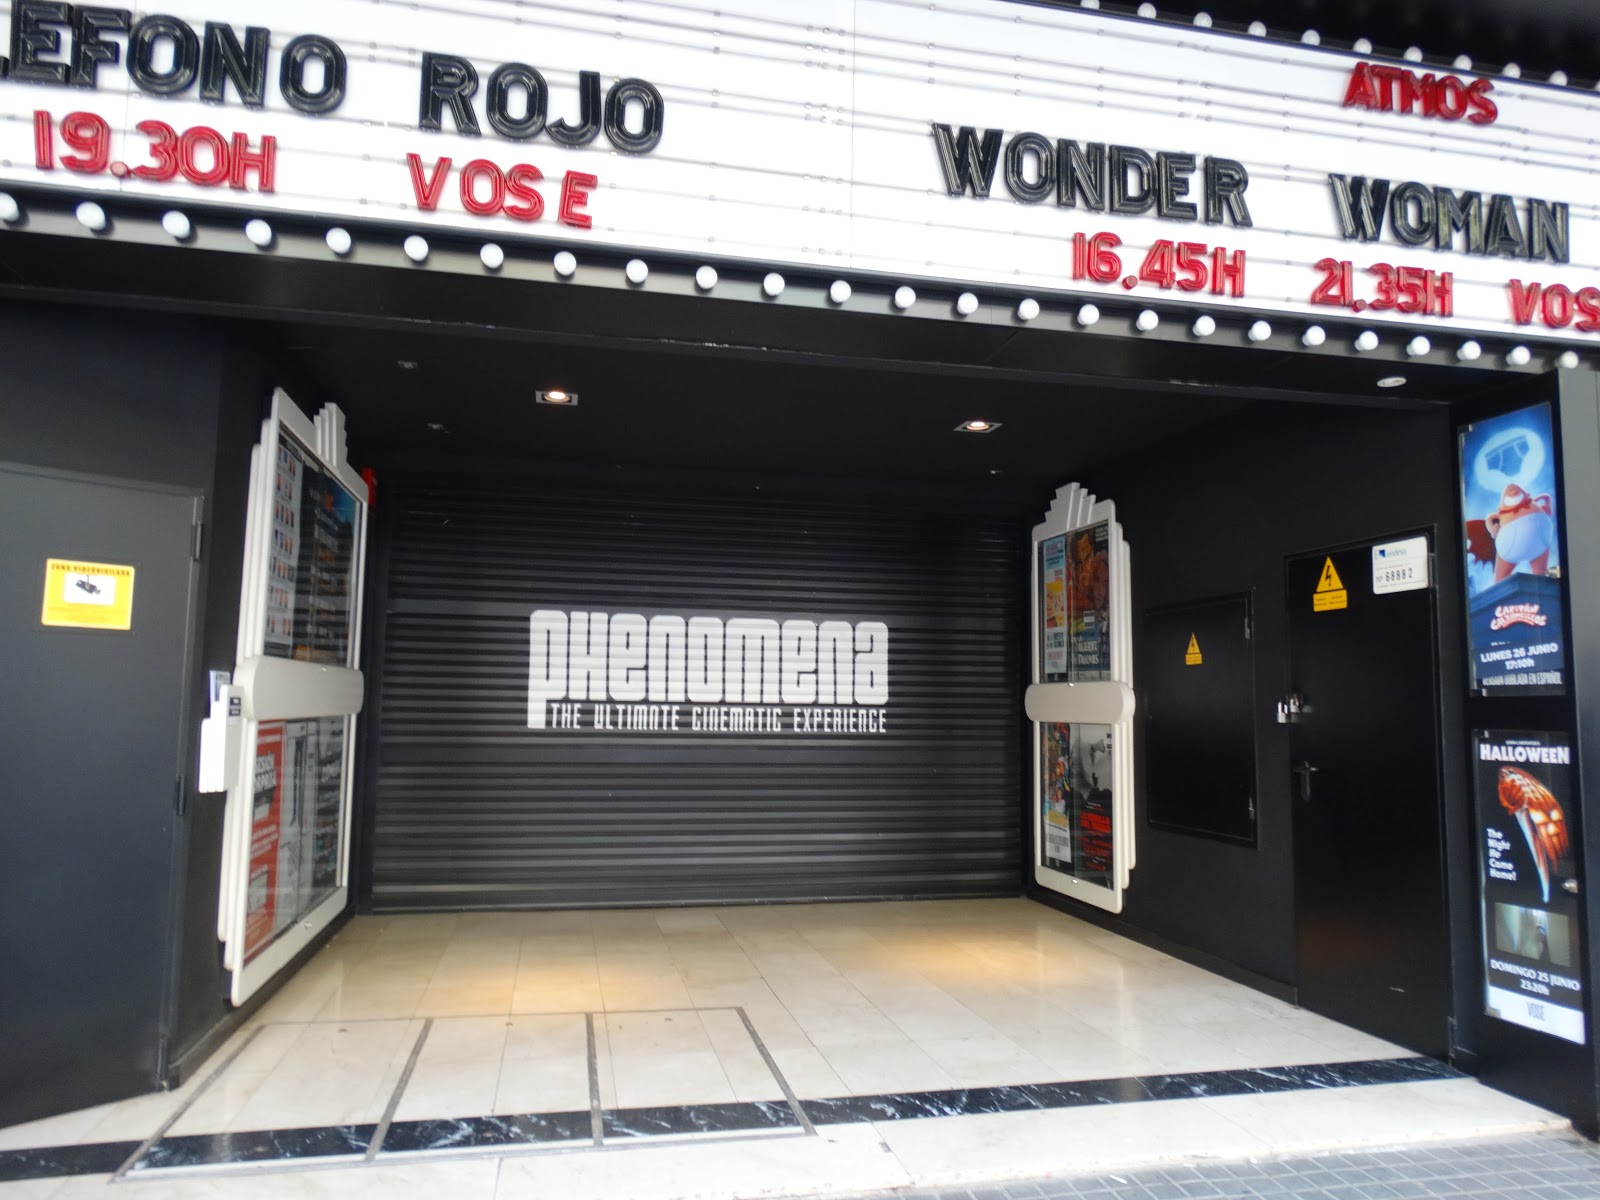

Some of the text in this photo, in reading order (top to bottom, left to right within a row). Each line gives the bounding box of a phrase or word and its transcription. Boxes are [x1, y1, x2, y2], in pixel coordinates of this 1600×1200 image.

[0, 0, 665, 154] EFONO ROJO
[1342, 61, 1499, 126] ATMOS
[32, 109, 598, 229] 19.30H VOSE
[931, 122, 1570, 263] WONDER WOMAN
[1072, 231, 1600, 333] 16.45H 21.35H VOS
[1480, 650, 1512, 662] LUNES
[1527, 642, 1558, 656] JUNIO
[551, 703, 888, 734] THE ULTIMATE CINEMATIC EXPERIENCE
[1480, 743, 1570, 764] HALLOWEEN
[1486, 828, 1503, 840] The
[1488, 838, 1511, 851] Night
[1489, 858, 1514, 870] Came
[1490, 959, 1538, 980] DOMINGO
